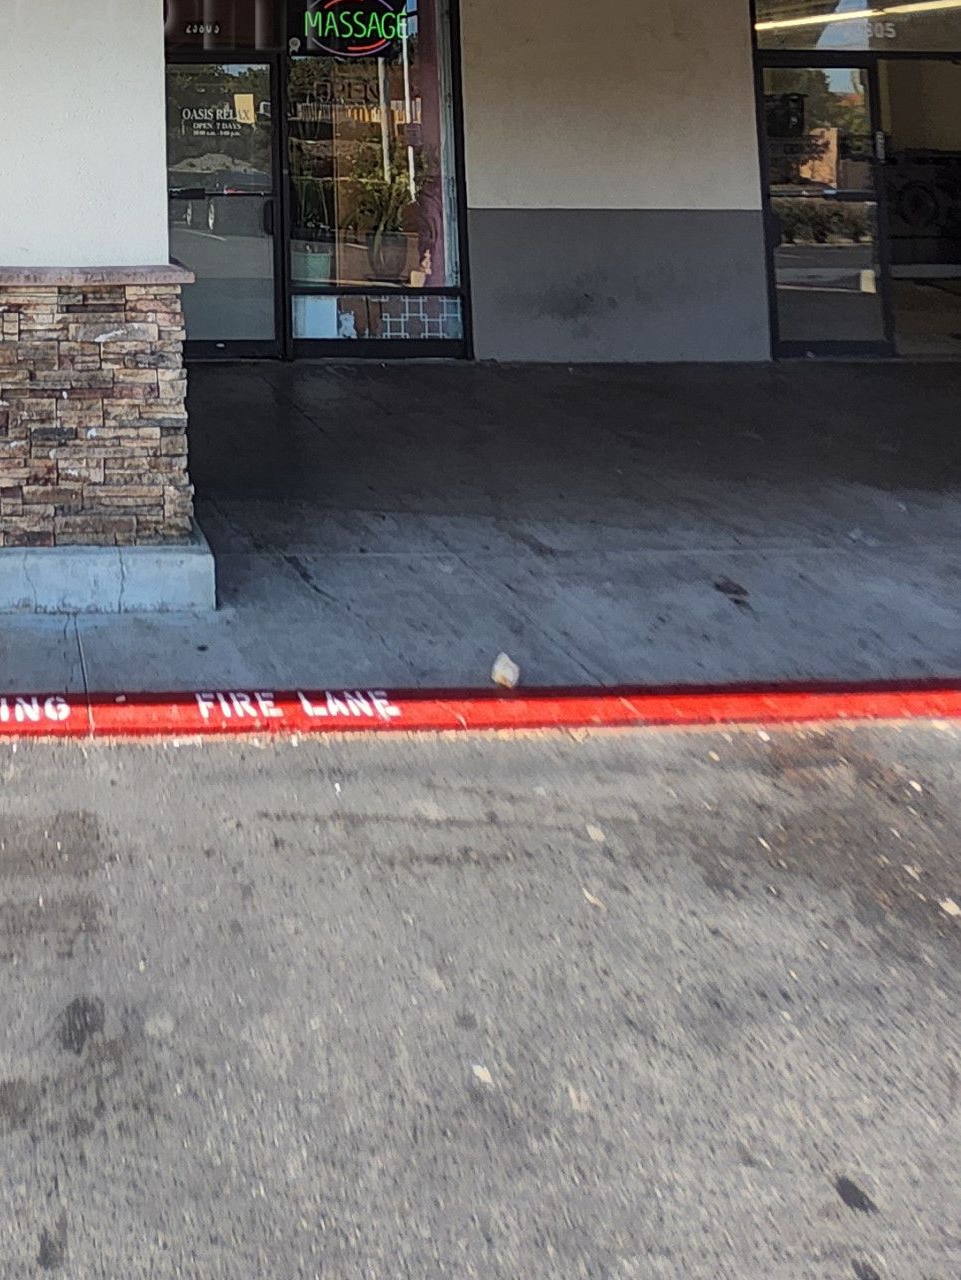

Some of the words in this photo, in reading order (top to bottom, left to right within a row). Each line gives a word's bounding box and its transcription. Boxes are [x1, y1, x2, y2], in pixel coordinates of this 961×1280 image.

[304, 10, 408, 40] MASSAGE
[182, 108, 214, 120] OASIS
[193, 122, 213, 130] OPEN
[195, 691, 283, 717] FIRE
[301, 690, 401, 718] LANE
